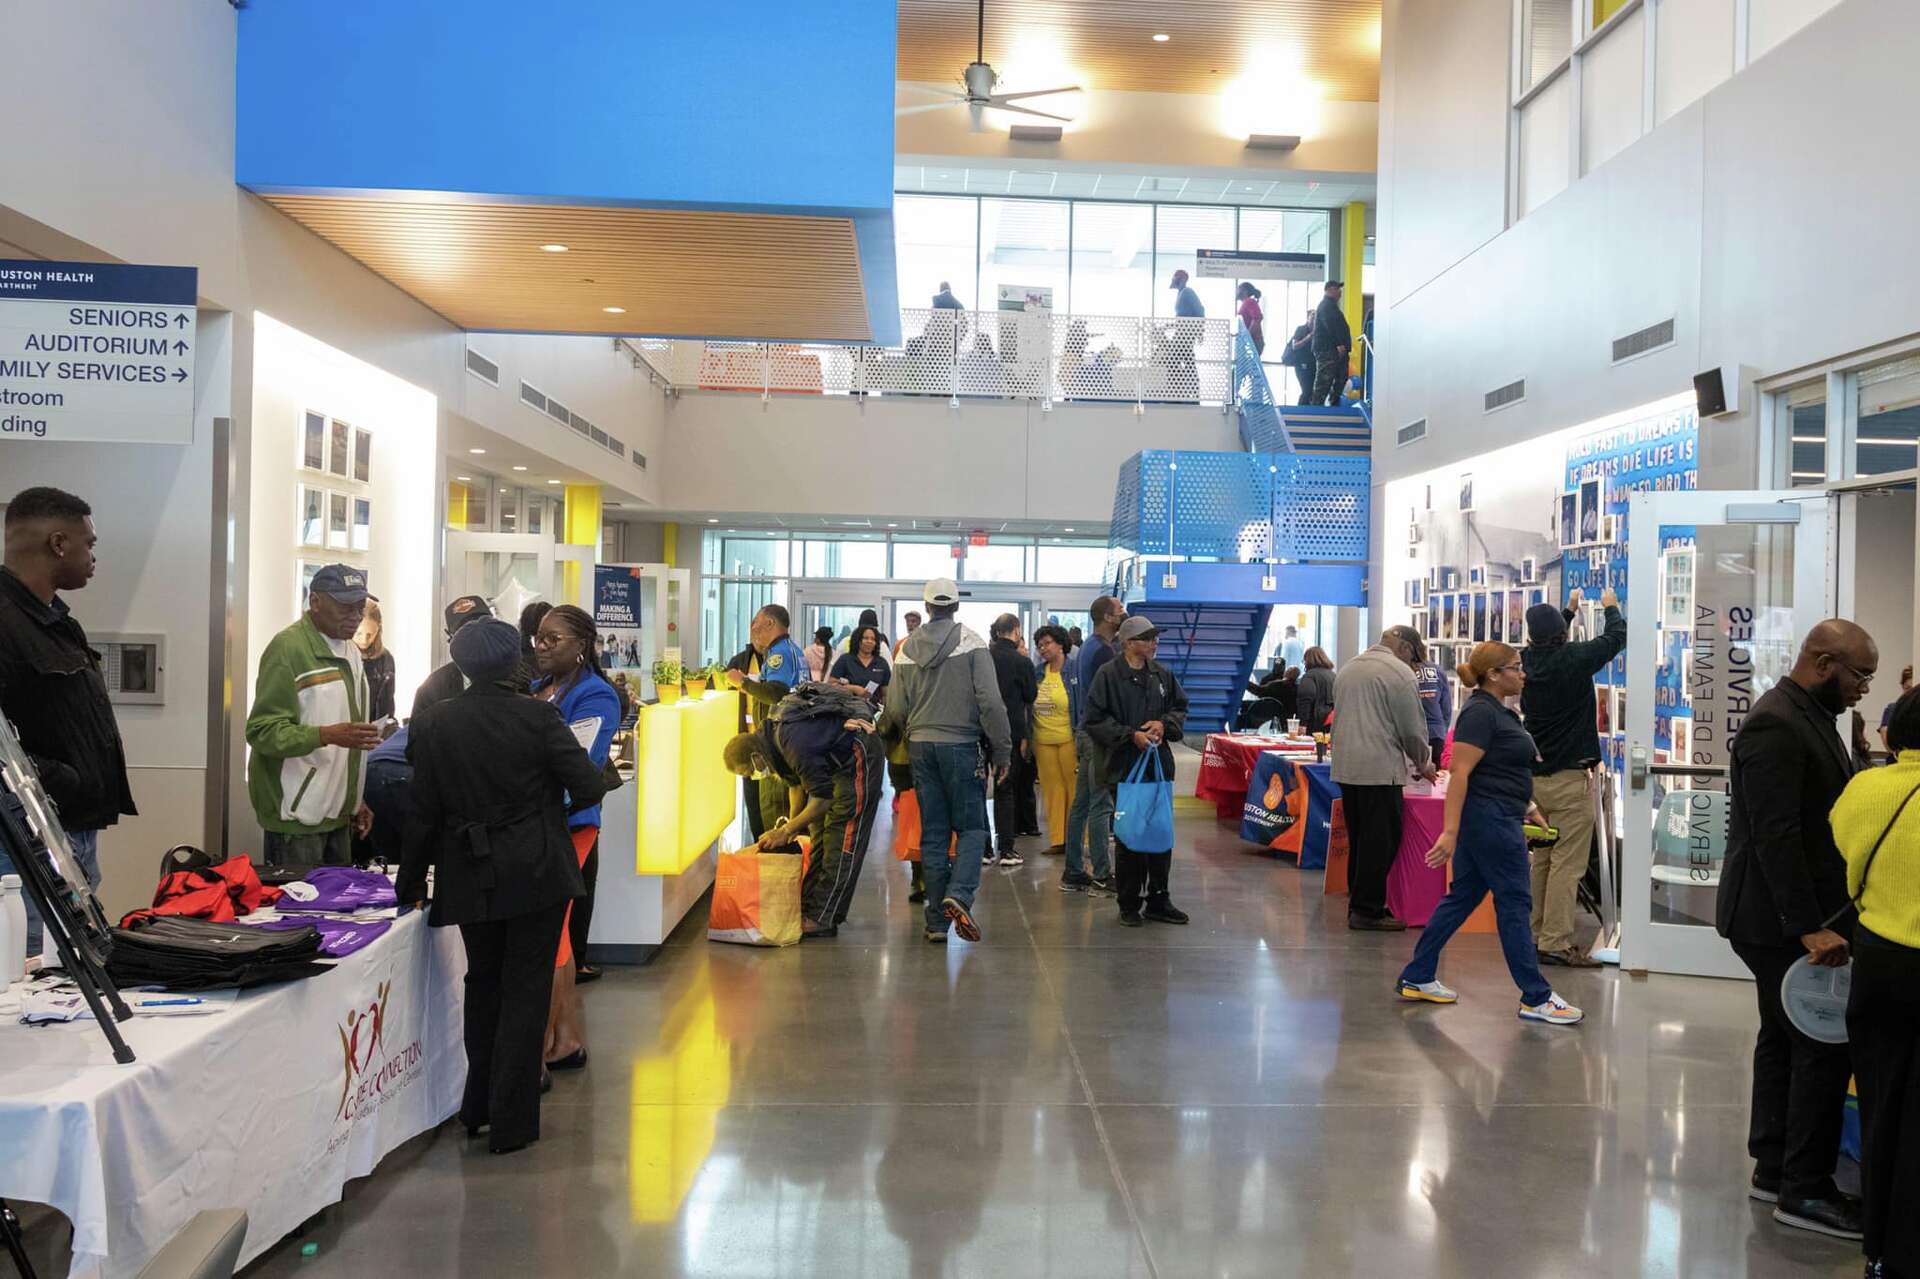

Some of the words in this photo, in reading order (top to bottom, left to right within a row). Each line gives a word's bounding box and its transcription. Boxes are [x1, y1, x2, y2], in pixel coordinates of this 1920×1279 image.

[46, 272, 94, 283] HEALTH
[69, 308, 168, 328] SENIORS
[25, 334, 168, 356] AUDITORIUM
[57, 362, 167, 383] SERVICES
[1, 416, 47, 437] ding
[1569, 467, 1580, 485] IF
[1581, 455, 1619, 481] DREAMS
[1622, 449, 1642, 473] DIE
[1646, 443, 1675, 467] LIFE
[1679, 438, 1694, 461] IS
[596, 612, 634, 621] DIFFERENCE
[600, 604, 625, 613] MAKING
[626, 605, 631, 613] A
